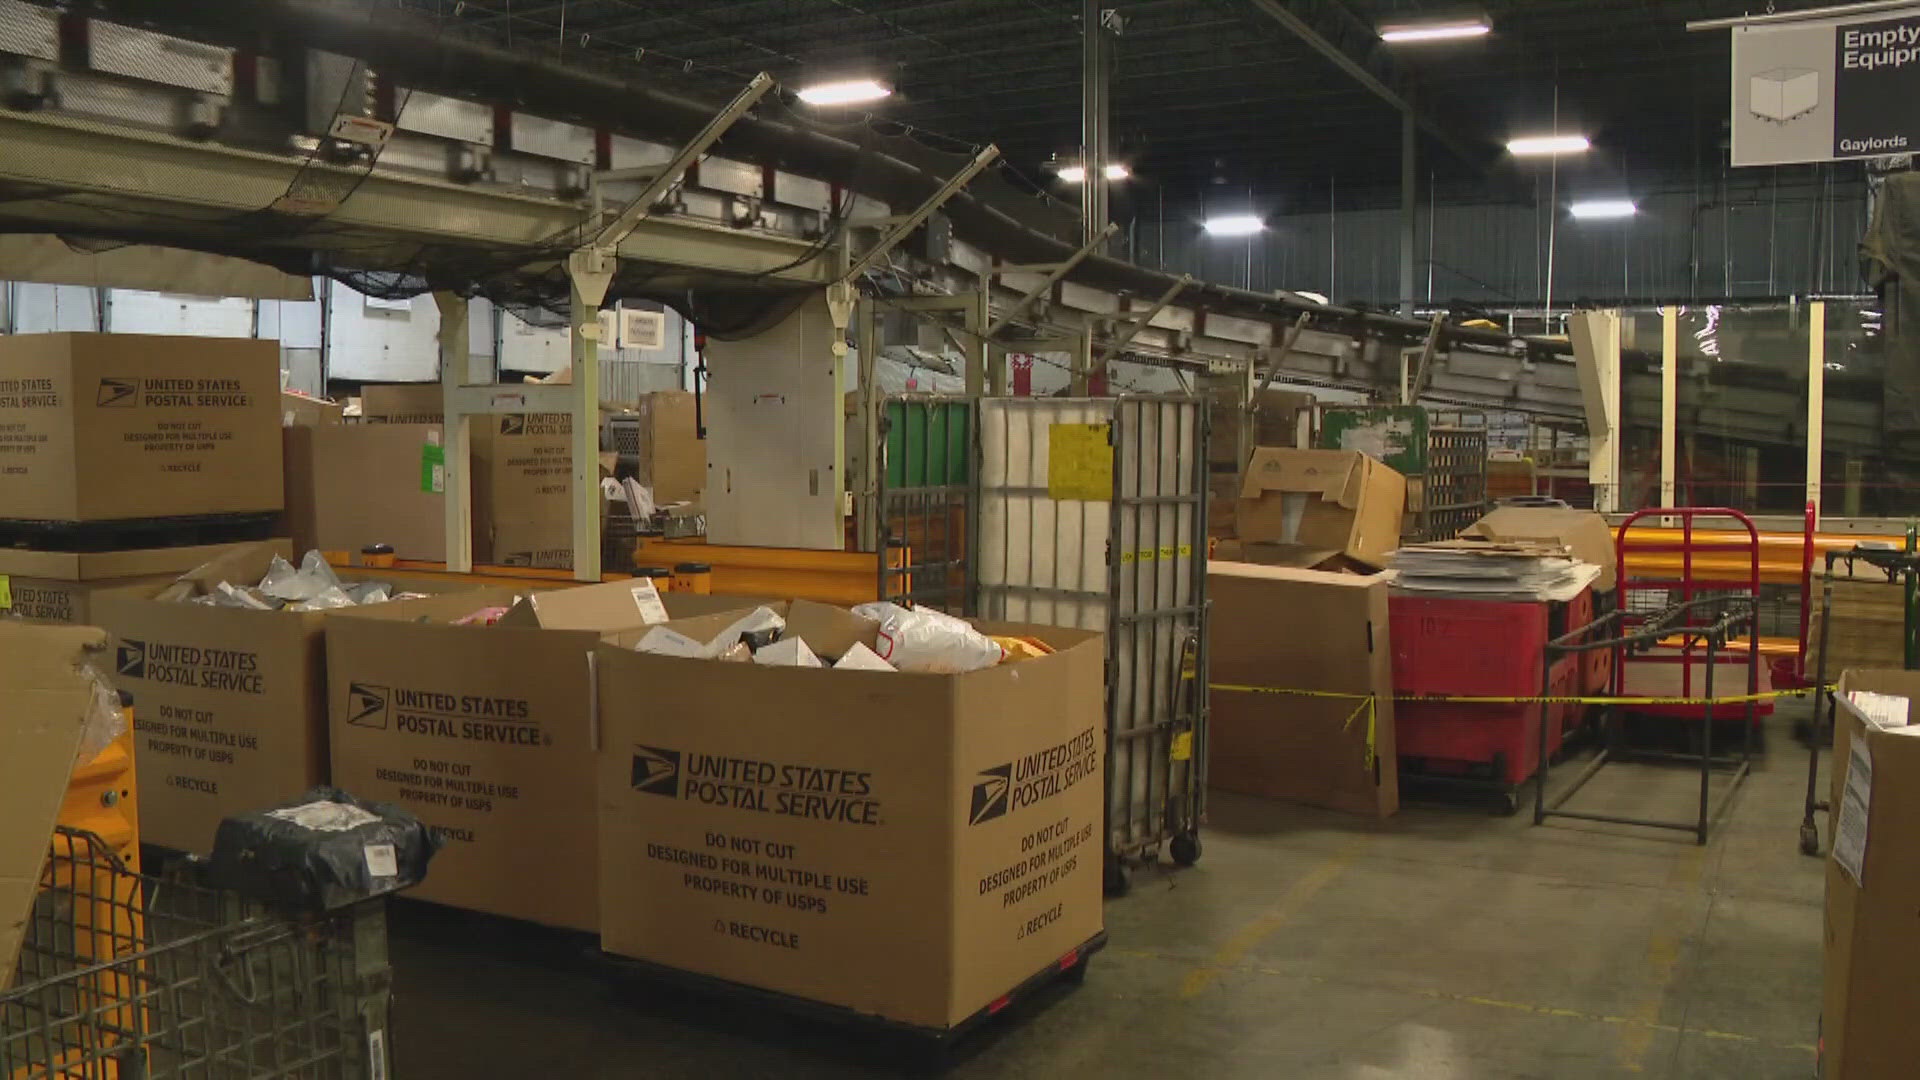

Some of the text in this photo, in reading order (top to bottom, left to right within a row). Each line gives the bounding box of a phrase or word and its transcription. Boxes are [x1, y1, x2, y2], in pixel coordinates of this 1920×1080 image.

[1844, 25, 1920, 48] Empty
[1840, 135, 1908, 152] Gaylords
[22, 379, 52, 391] STATES
[145, 379, 241, 391] UNITED STATES
[22, 395, 57, 408] SERVICE
[145, 395, 247, 407] POSTAL SERVICE
[526, 425, 557, 434] POSTAL
[527, 412, 559, 424] UNITED
[37, 590, 70, 605] STATES
[36, 605, 72, 622] SERVICE
[149, 643, 258, 671] UNITED STATES
[148, 663, 262, 694] POSTAL SERVICE
[160, 705, 214, 723] DO NOT CUT
[395, 688, 529, 718] UNITED STATES
[170, 725, 188, 738] FOR
[190, 729, 236, 746] MULTIPLE
[239, 735, 258, 750] USE
[397, 714, 541, 746] POSTAL SERVICE
[148, 739, 233, 763] PROPERTY OF USPS
[1015, 726, 1095, 783] UNITED STATES
[413, 759, 471, 776] DO NOT CUT
[688, 753, 871, 796] UNITED STATES
[1011, 750, 1096, 812] POSTAL SERVICE
[176, 776, 218, 794] RECYCLE
[376, 768, 518, 799] DESIGNED FOR MULTIPLE USE
[400, 788, 492, 812] PROPERTY OF USPS
[685, 779, 881, 826] POSTAL SERVICE
[705, 831, 796, 860] DO NOT CUT
[1021, 817, 1069, 852] DO NOT CUT
[647, 843, 869, 896] DESIGNED FOR MULTIPLE USE
[979, 823, 1092, 896] DESIGNED FOR MULTIPLE USE
[684, 873, 827, 914] PROPERTY OF USPS
[1003, 856, 1078, 909] PROPERTY OF USPS
[1026, 903, 1063, 936] RECYCLE
[730, 921, 799, 949] RECYCLE
